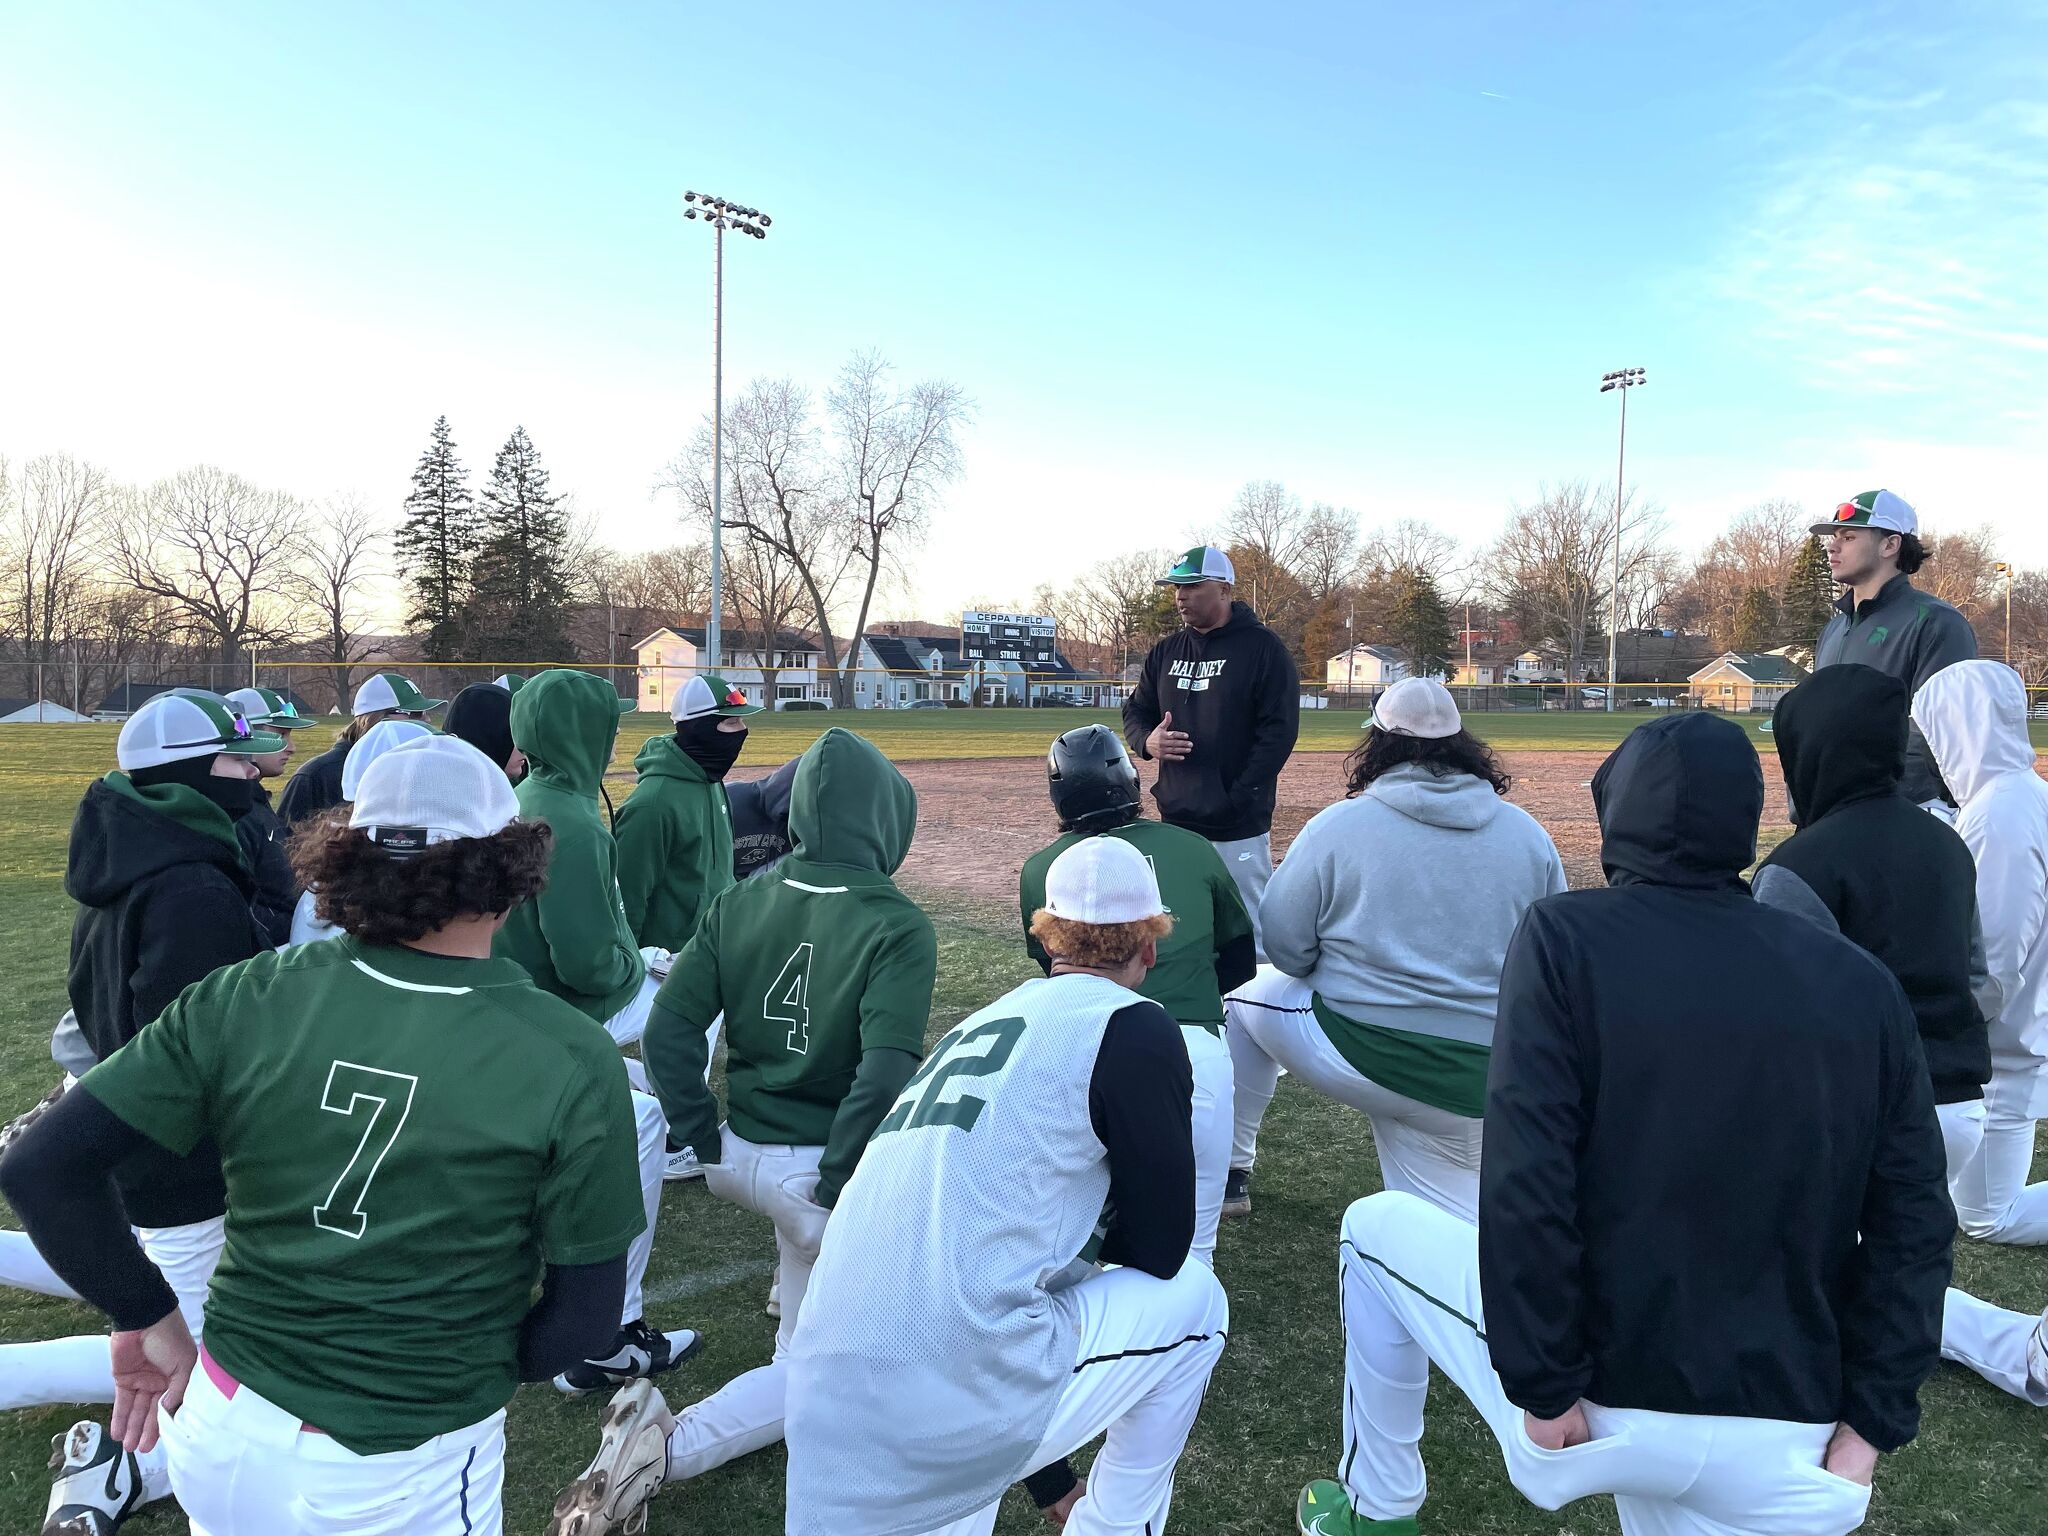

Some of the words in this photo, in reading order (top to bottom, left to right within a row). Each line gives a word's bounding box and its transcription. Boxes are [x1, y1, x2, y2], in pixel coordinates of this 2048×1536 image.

[977, 613, 1011, 623] CEPPA
[1015, 616, 1043, 625] FIELD
[966, 624, 986, 632] HOME
[1031, 628, 1054, 636] VISITOR
[968, 648, 984, 658] BALL
[1000, 650, 1021, 660] STRIKE
[1038, 652, 1050, 661] OUT
[763, 942, 813, 1055] 4
[313, 1059, 418, 1240] 7
